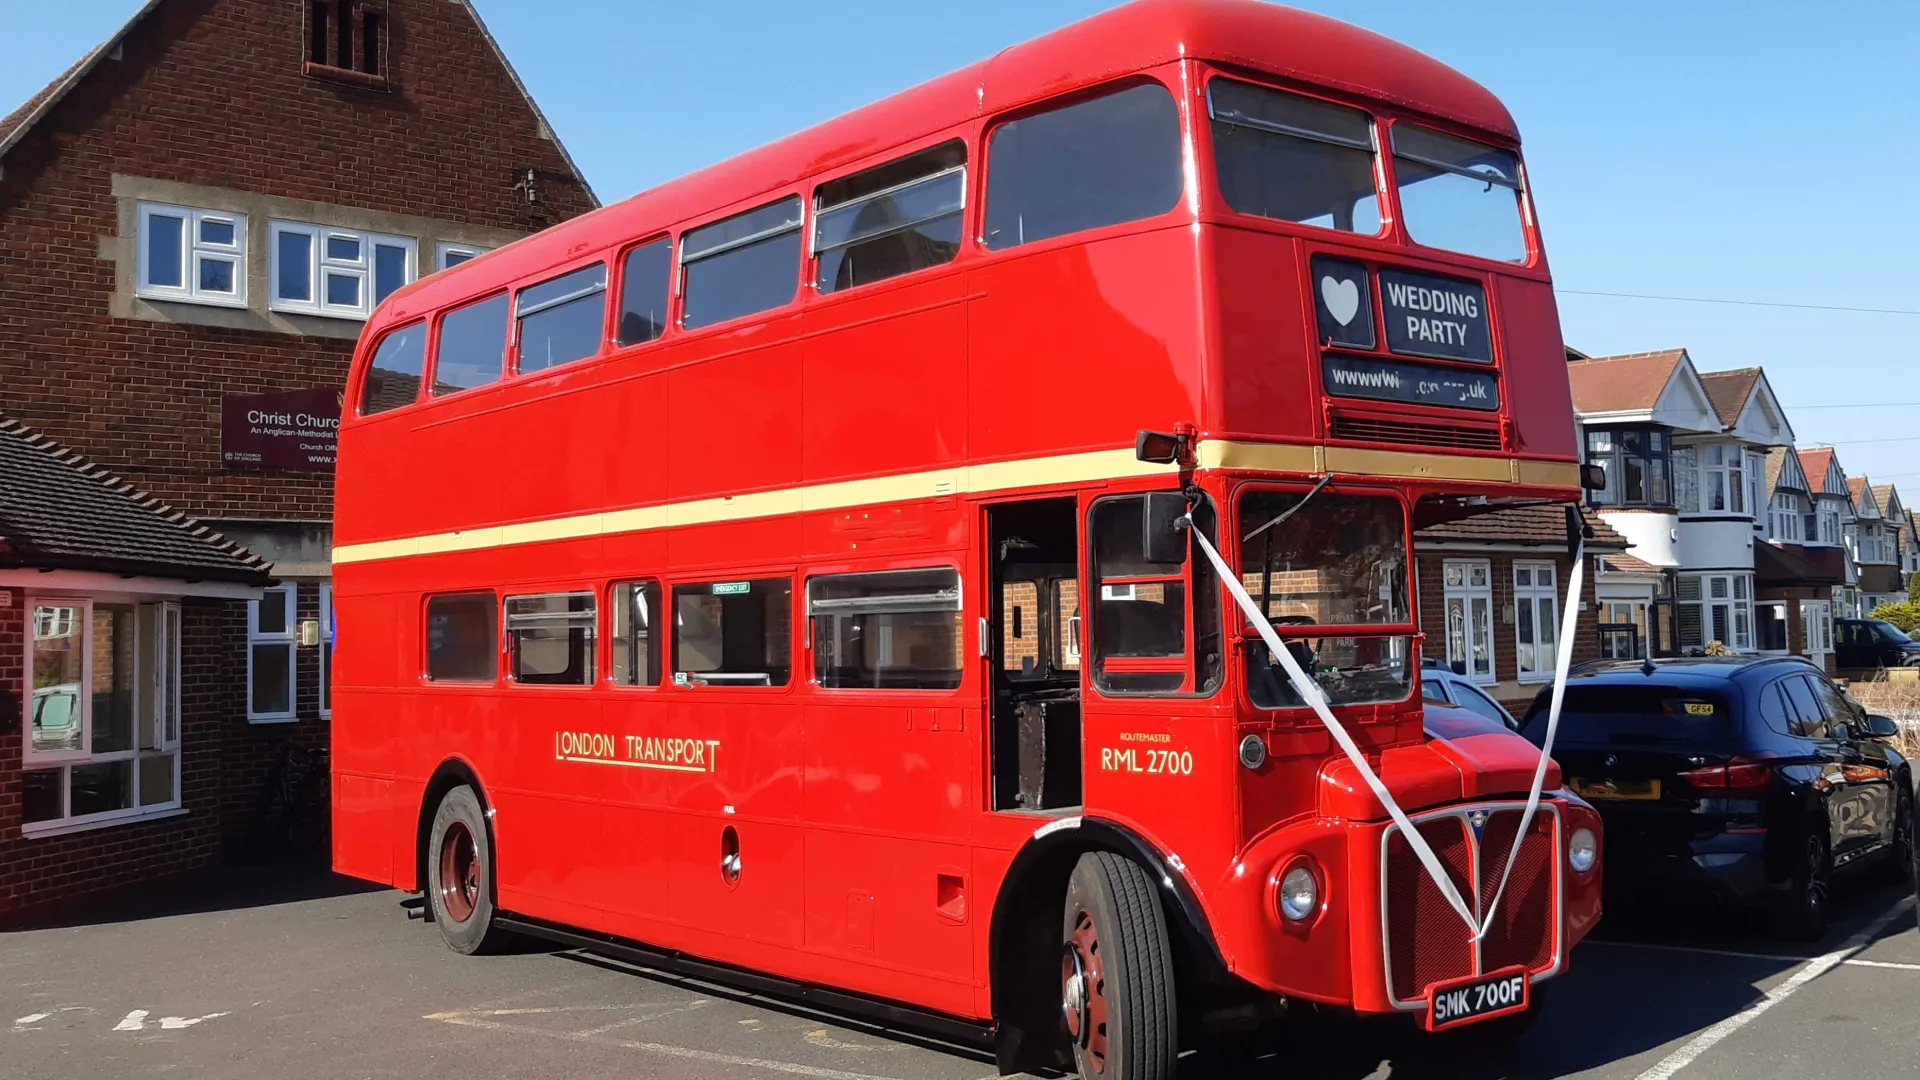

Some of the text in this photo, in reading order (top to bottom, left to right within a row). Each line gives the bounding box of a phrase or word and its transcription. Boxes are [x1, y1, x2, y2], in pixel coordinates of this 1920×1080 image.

[1387, 282, 1478, 318] WEDDING
[1406, 316, 1467, 346] PARTY
[247, 410, 340, 428] Christ Churc
[250, 426, 262, 435] An
[263, 428, 334, 439] Anglican-Methodist
[299, 443, 323, 451] Church
[1330, 614, 1355, 622] PRIVAT
[1120, 732, 1171, 742] ROUTEMASTER
[555, 731, 720, 773] LONDON TRANSPORT
[1102, 747, 1193, 775] RML 2700
[1435, 976, 1523, 1019] SMK 700F
